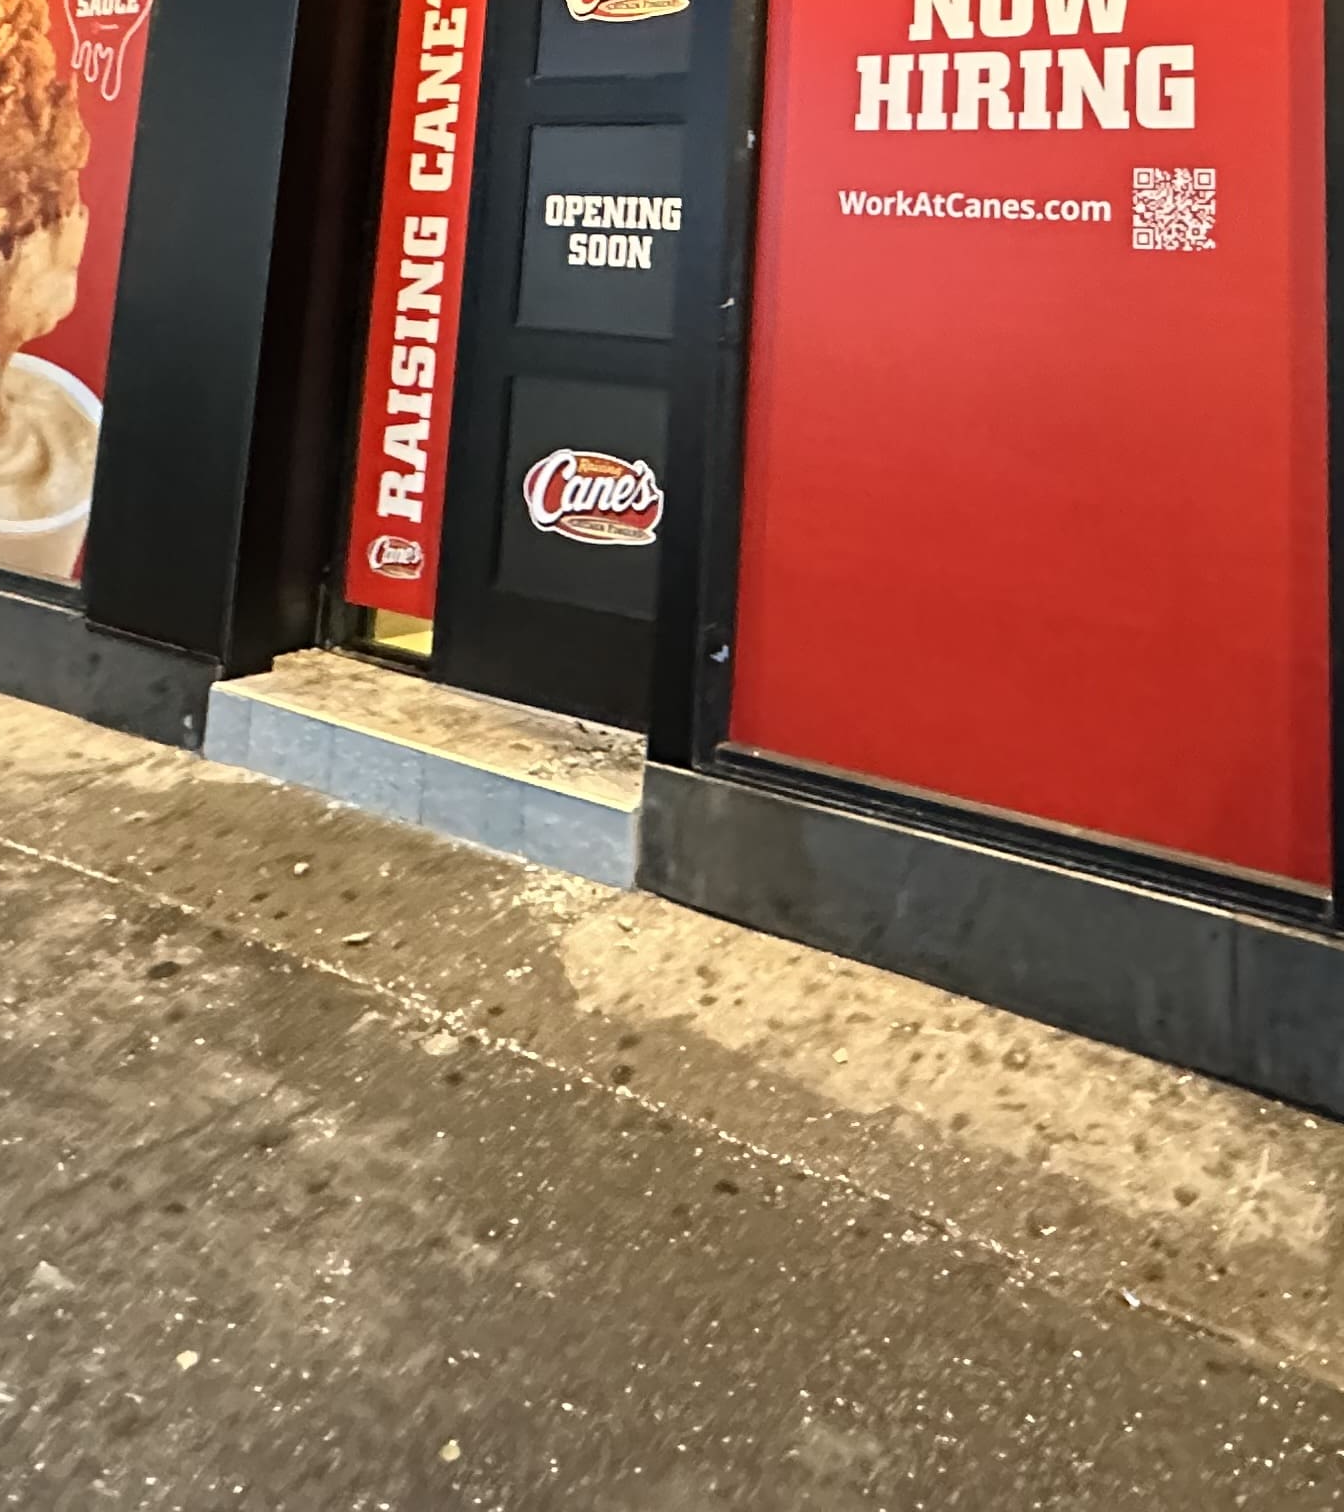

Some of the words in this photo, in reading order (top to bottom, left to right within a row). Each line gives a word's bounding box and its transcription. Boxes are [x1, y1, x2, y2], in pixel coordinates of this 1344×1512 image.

[854, 44, 1196, 131] HIRING
[545, 194, 683, 232] OPENING
[838, 190, 1112, 222] WorkAtCanes.com
[568, 233, 654, 269] SOON
[376, 215, 449, 524] RAISING
[532, 451, 659, 524] Cane's
